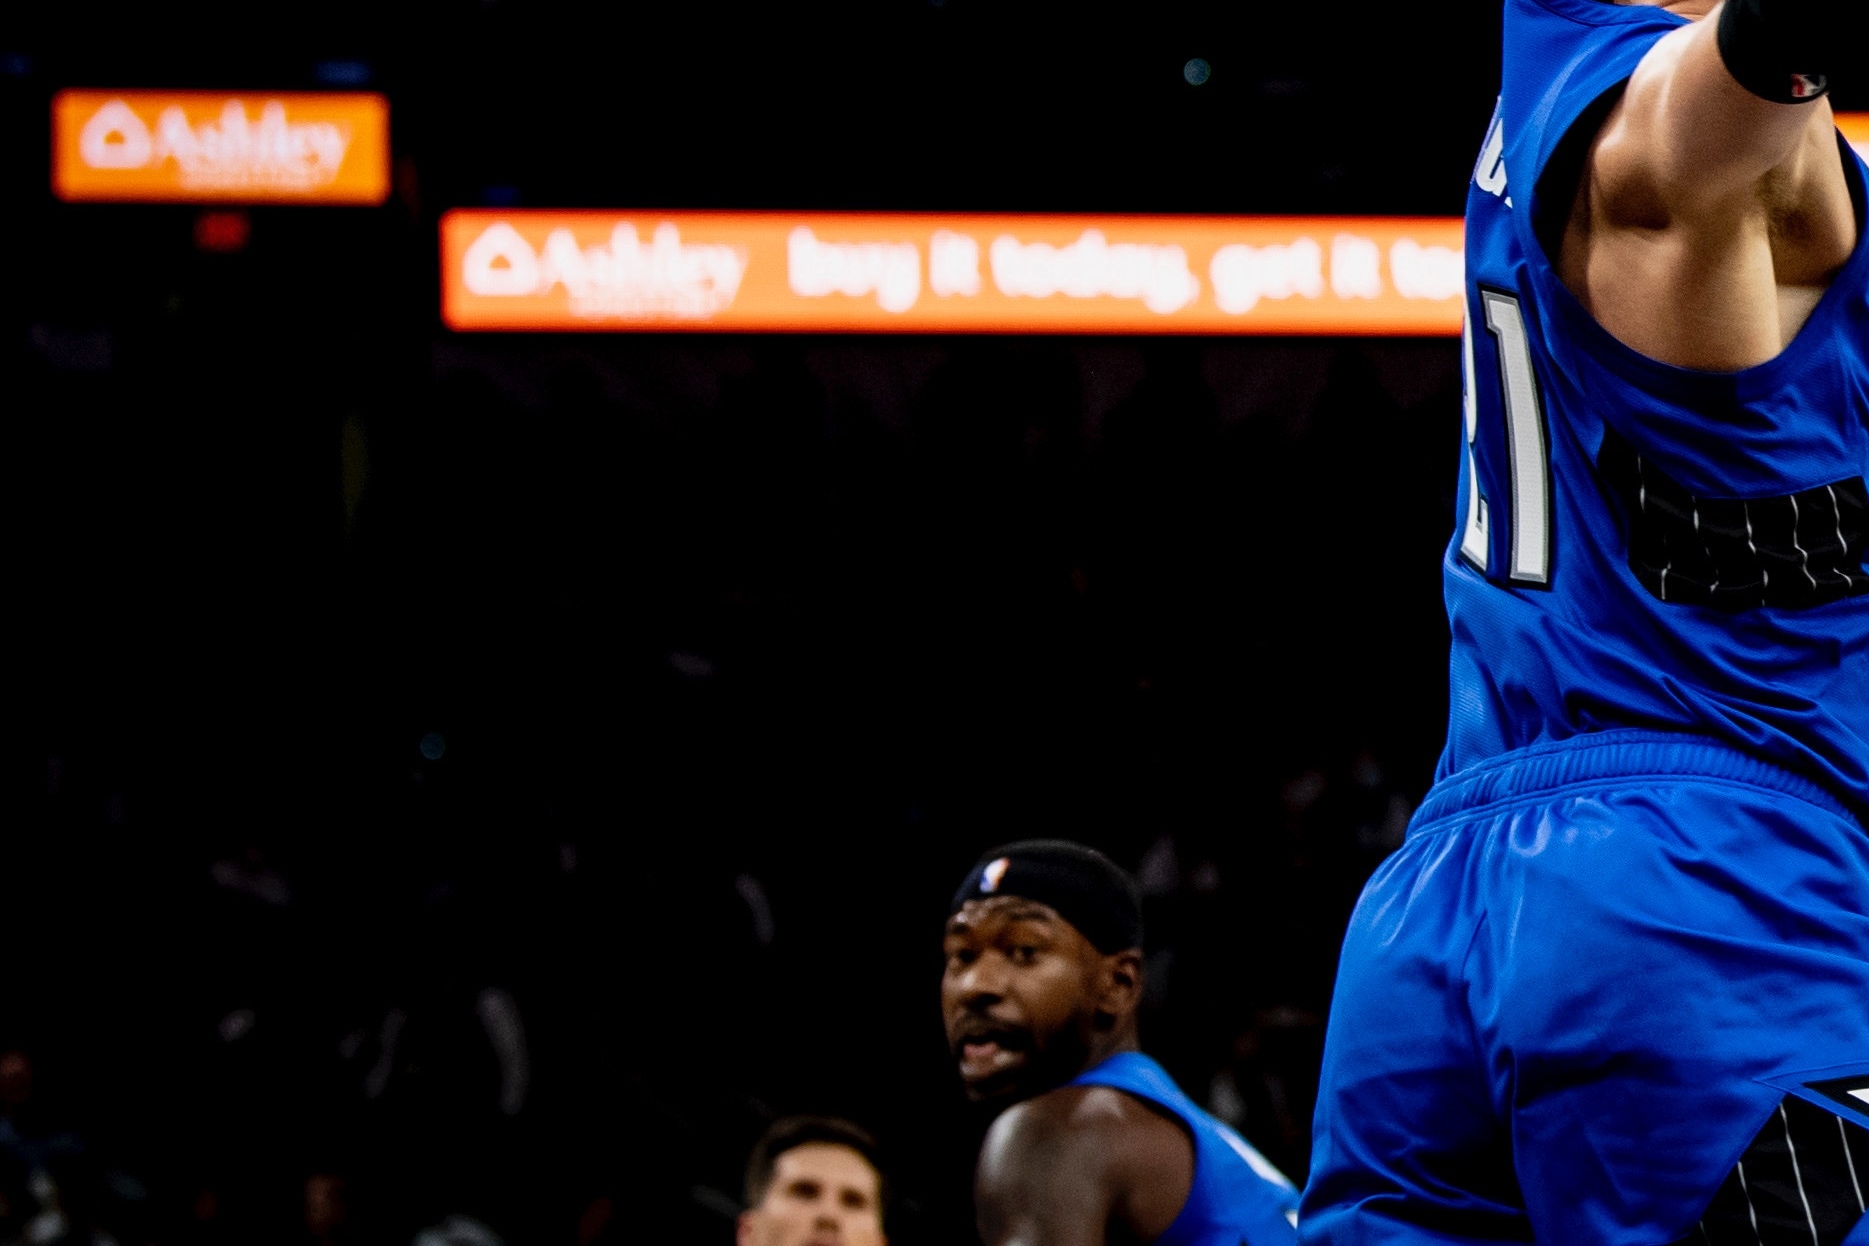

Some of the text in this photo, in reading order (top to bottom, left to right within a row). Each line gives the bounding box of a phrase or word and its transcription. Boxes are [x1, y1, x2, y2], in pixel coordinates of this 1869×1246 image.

[787, 225, 921, 313] buy
[929, 229, 980, 298] it
[1209, 238, 1324, 314] get
[1330, 233, 1381, 300] it
